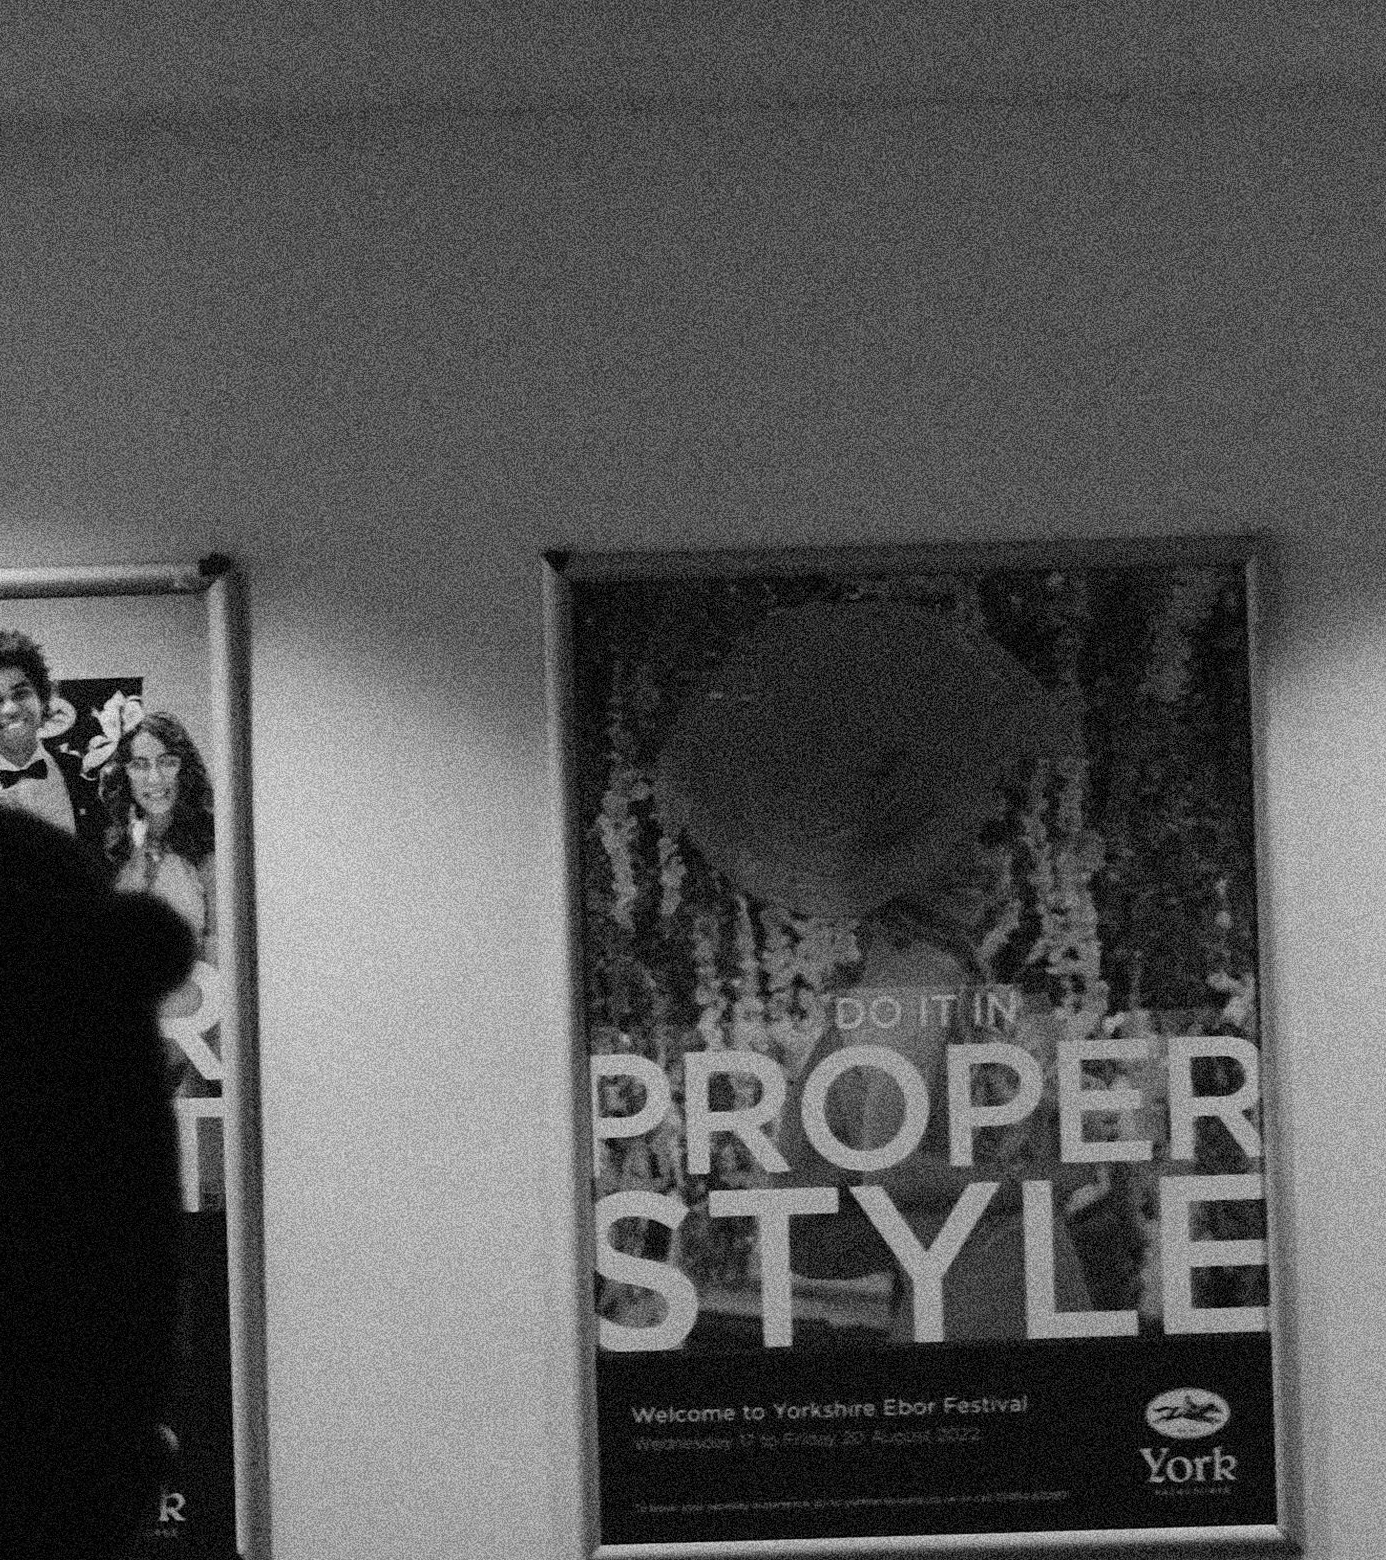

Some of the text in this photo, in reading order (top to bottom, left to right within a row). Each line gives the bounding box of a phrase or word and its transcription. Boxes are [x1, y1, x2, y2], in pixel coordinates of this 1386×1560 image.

[835, 991, 1017, 1030] DO IT IN
[590, 1036, 1261, 1179] PROPER
[595, 1174, 1270, 1352] STYLE
[631, 1394, 1029, 1426] Welcome to Yorkshire Ebor Festival
[1138, 1446, 1239, 1484] York
